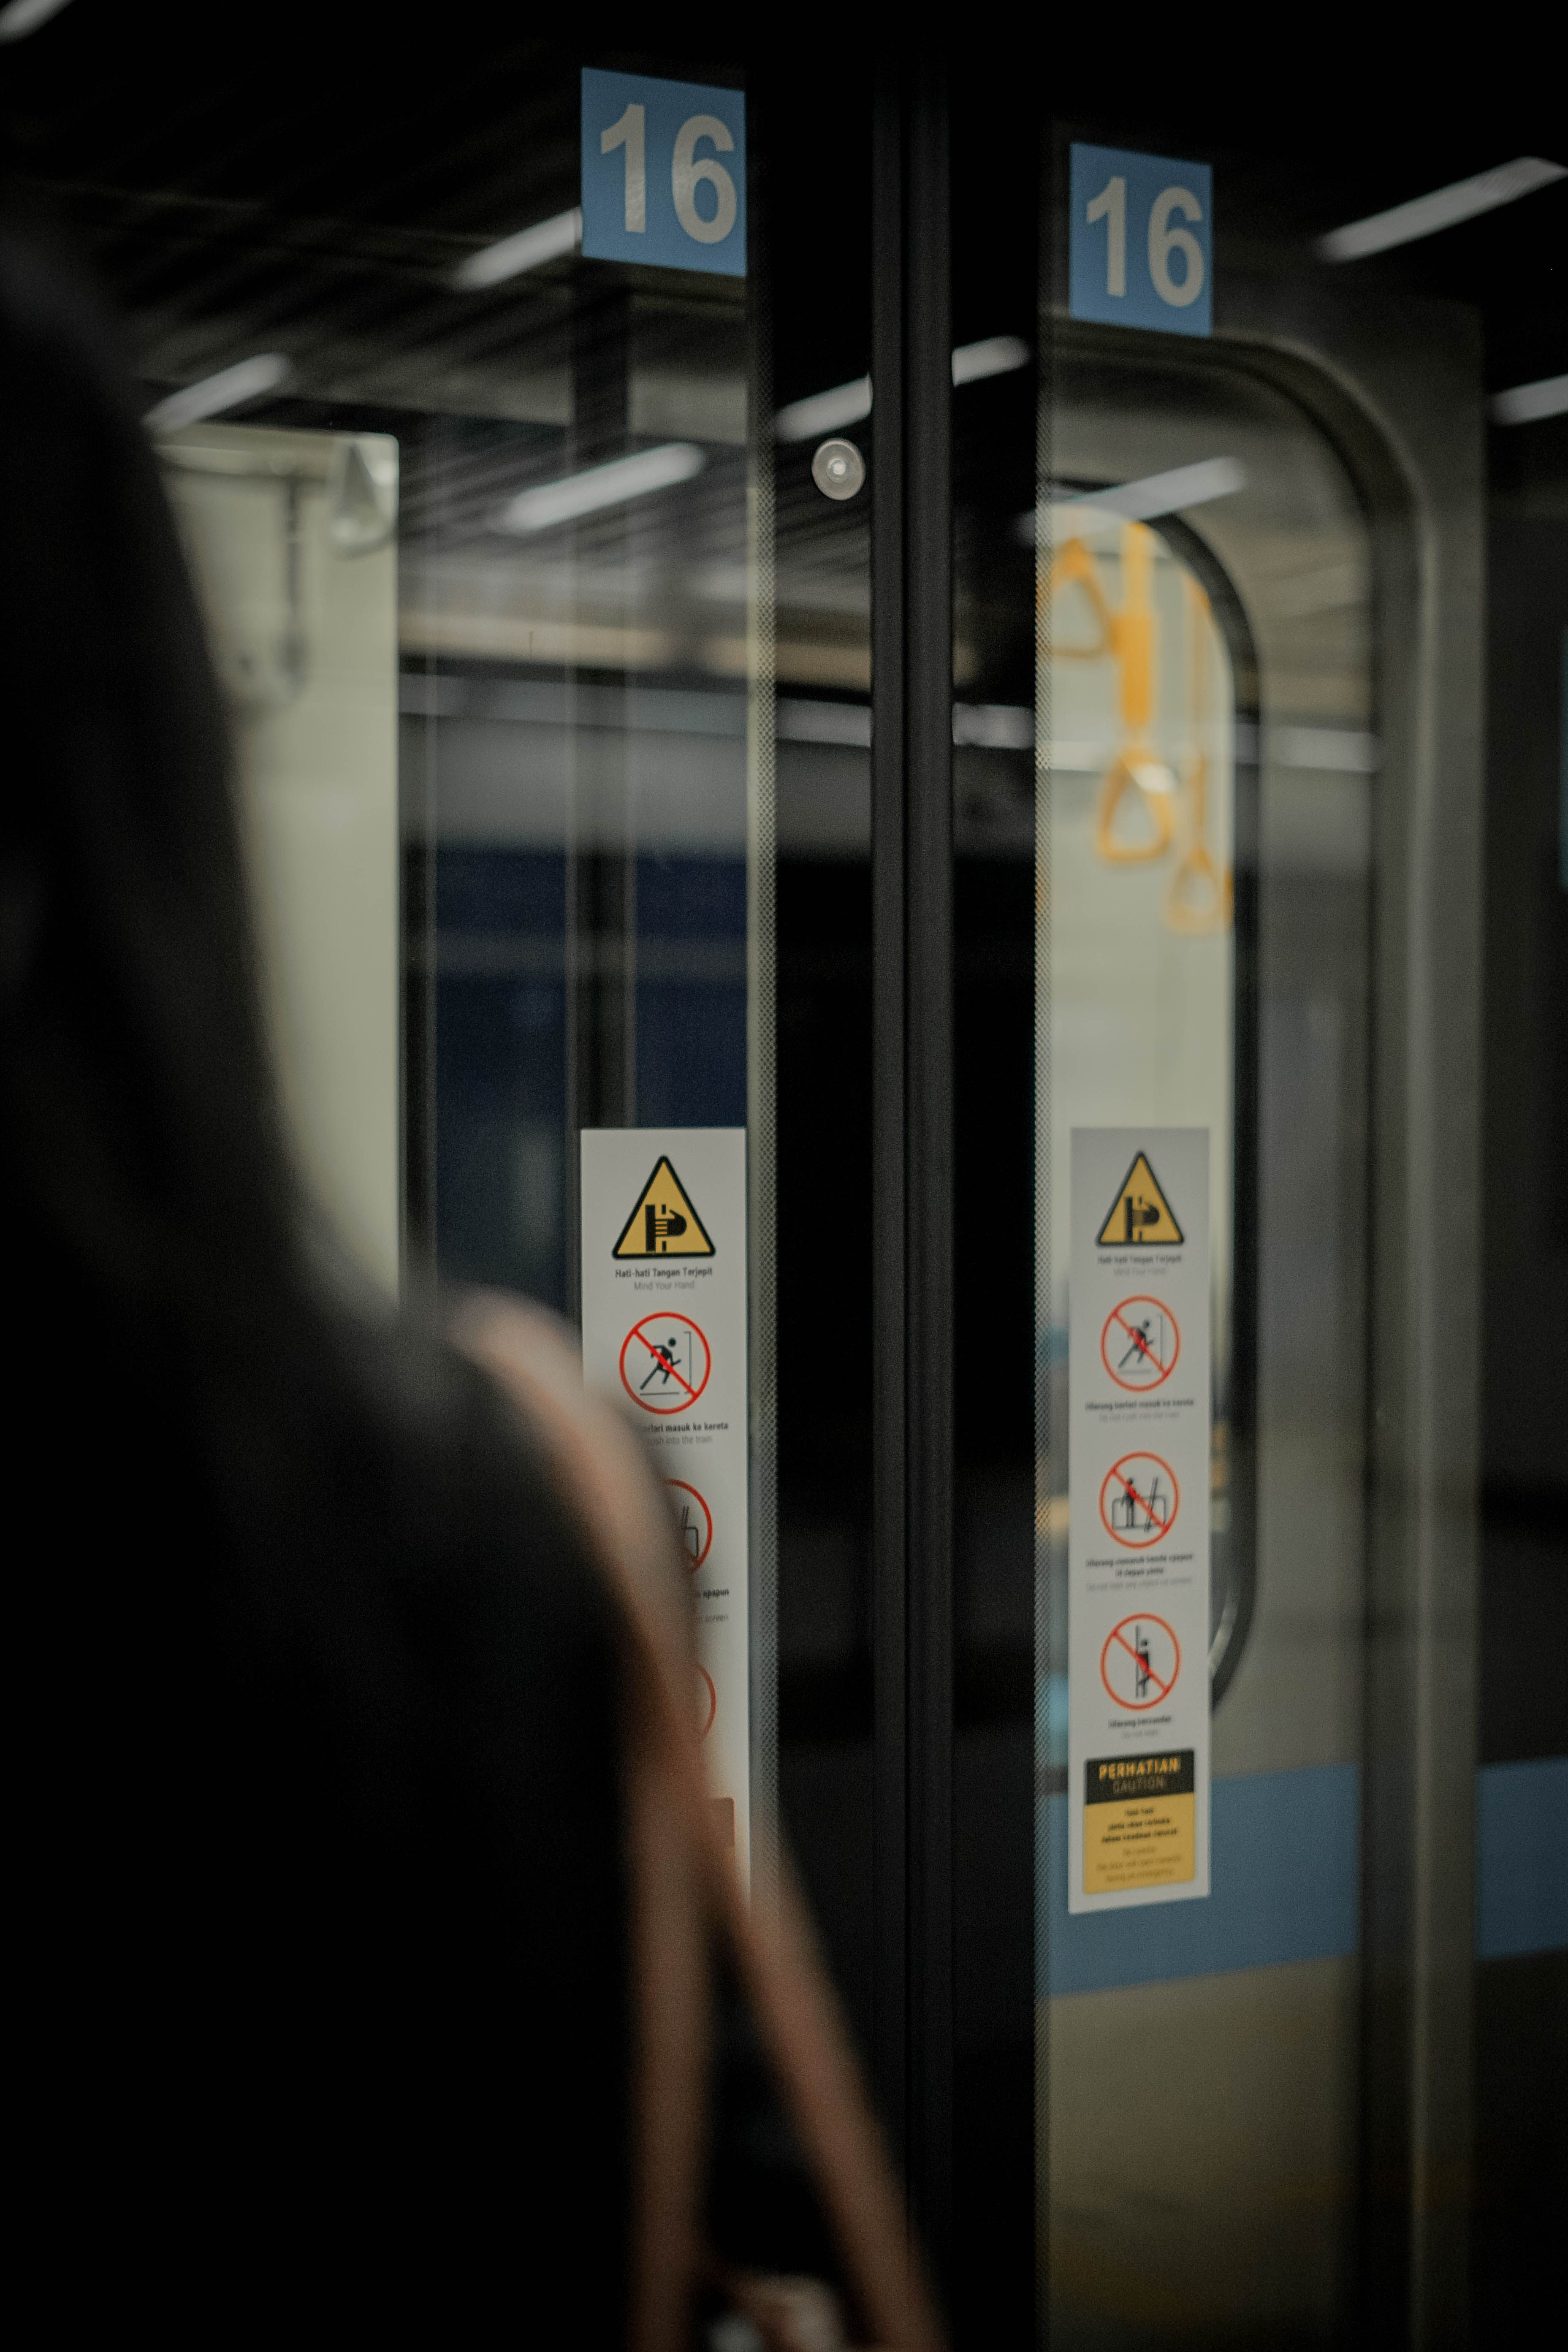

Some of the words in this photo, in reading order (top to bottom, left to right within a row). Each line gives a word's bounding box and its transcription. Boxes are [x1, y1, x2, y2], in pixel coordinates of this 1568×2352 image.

[601, 104, 737, 244] 16
[1087, 176, 1204, 307] 16
[615, 1268, 650, 1278] Hati-hati
[653, 1267, 681, 1278] Tangan
[683, 1267, 713, 1278] Terjepit
[634, 1281, 653, 1290] Mind
[656, 1281, 672, 1290] Your
[675, 1280, 694, 1289] Hand
[704, 1422, 729, 1430] kereta
[1099, 1757, 1181, 1780] PERHATIAN
[1113, 1773, 1165, 1794] CAUTION
